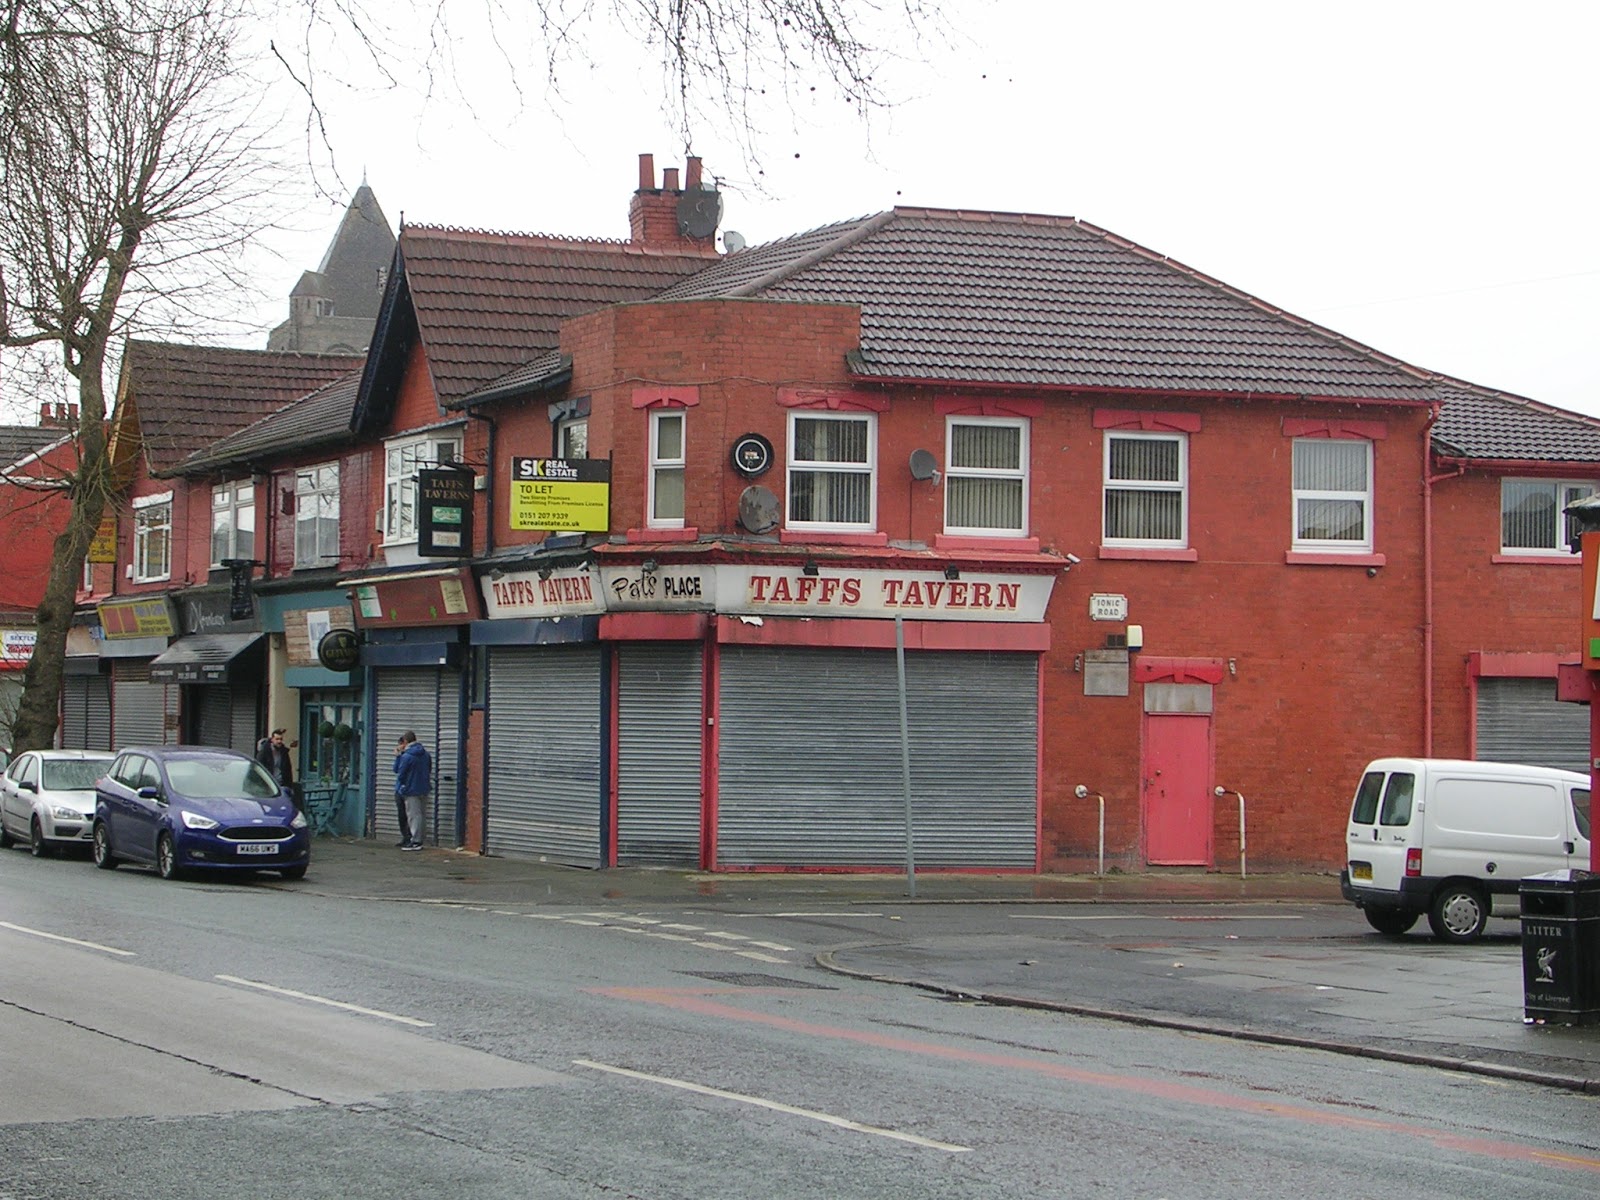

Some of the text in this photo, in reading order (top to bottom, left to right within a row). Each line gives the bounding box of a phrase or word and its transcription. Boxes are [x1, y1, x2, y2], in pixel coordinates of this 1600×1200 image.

[520, 459, 545, 476] SK
[545, 460, 569, 469] REAL
[545, 468, 578, 477] ESTATE
[432, 478, 464, 488] TAFFS
[424, 488, 470, 499] TAVERNS
[520, 485, 553, 494] TO LET
[493, 580, 534, 605] TAFFS
[538, 576, 593, 602] TAVERN
[664, 576, 702, 597] PLACE
[750, 576, 1021, 609] TAFFS TAVERN
[1097, 599, 1120, 607] IONIC
[1098, 608, 1119, 616] ROAD
[240, 844, 260, 853] MA66
[1526, 925, 1562, 937] LITTER
